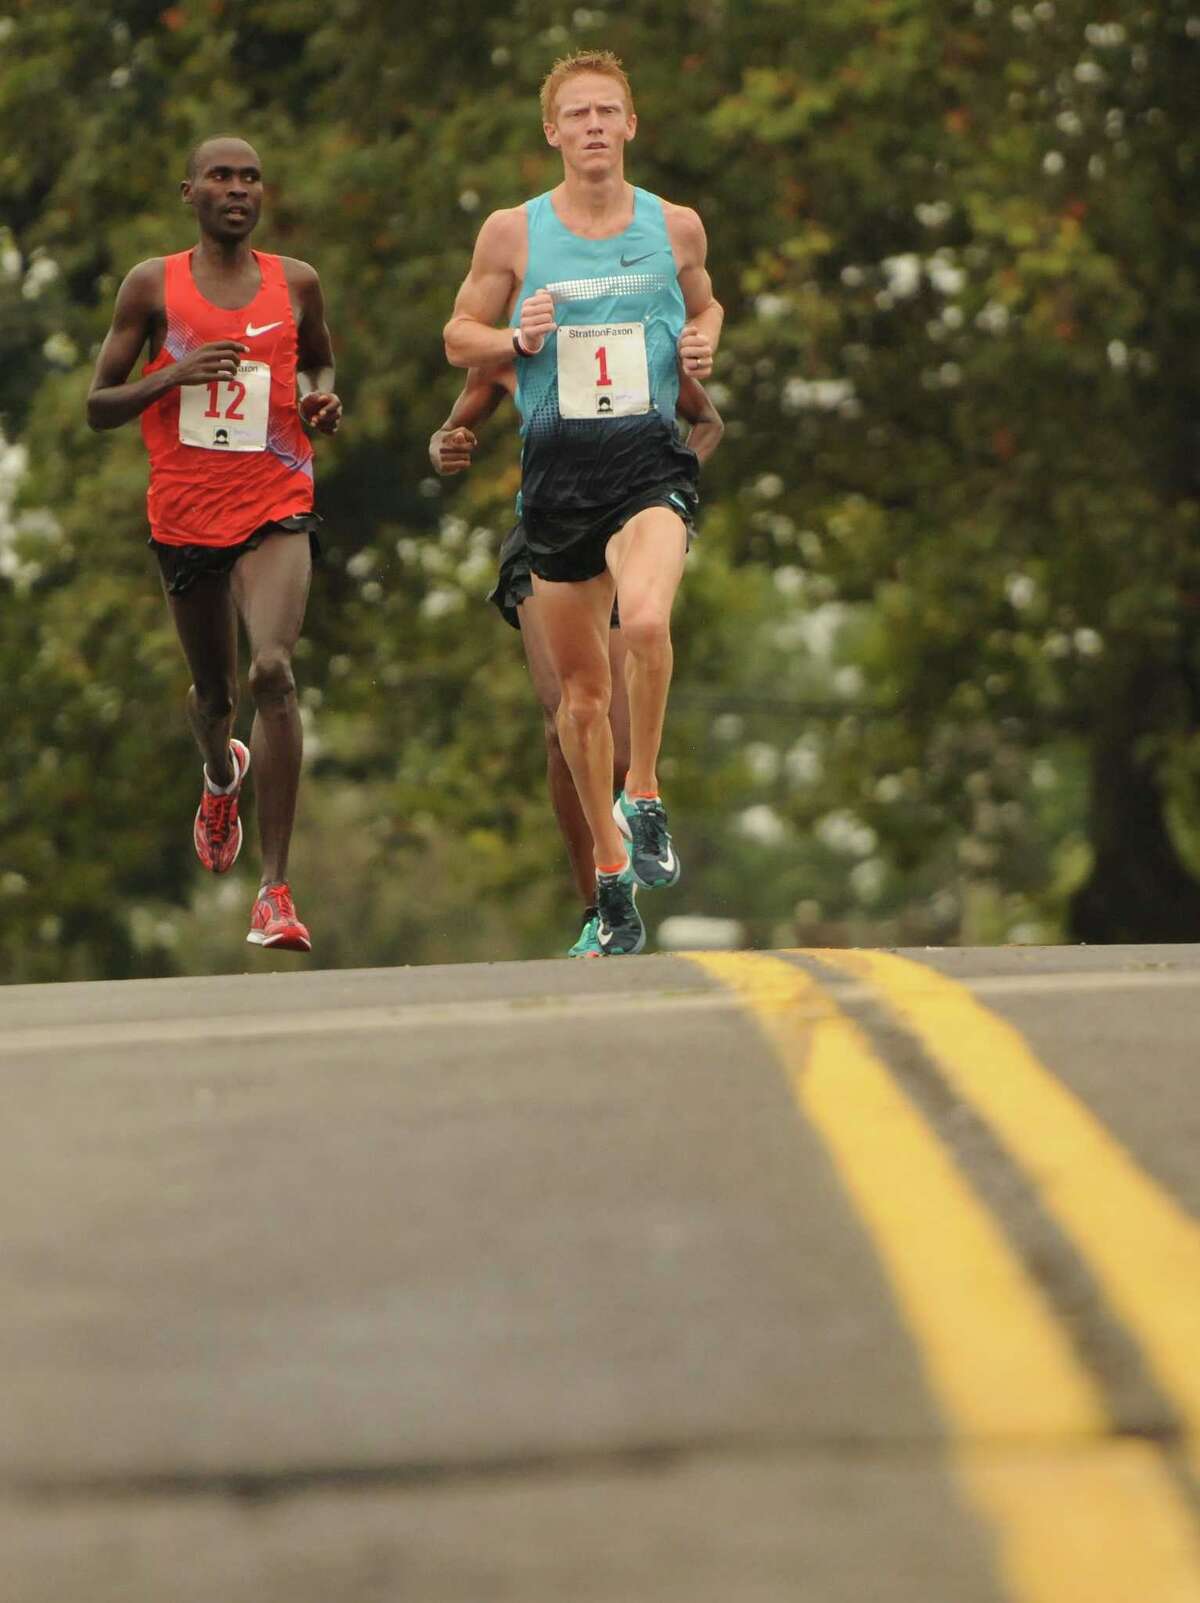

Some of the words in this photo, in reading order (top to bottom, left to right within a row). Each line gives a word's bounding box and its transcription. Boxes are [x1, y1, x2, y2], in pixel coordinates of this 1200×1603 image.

[569, 327, 633, 339] StrattonFaxon
[595, 346, 612, 386] 1
[204, 379, 246, 420] 12
